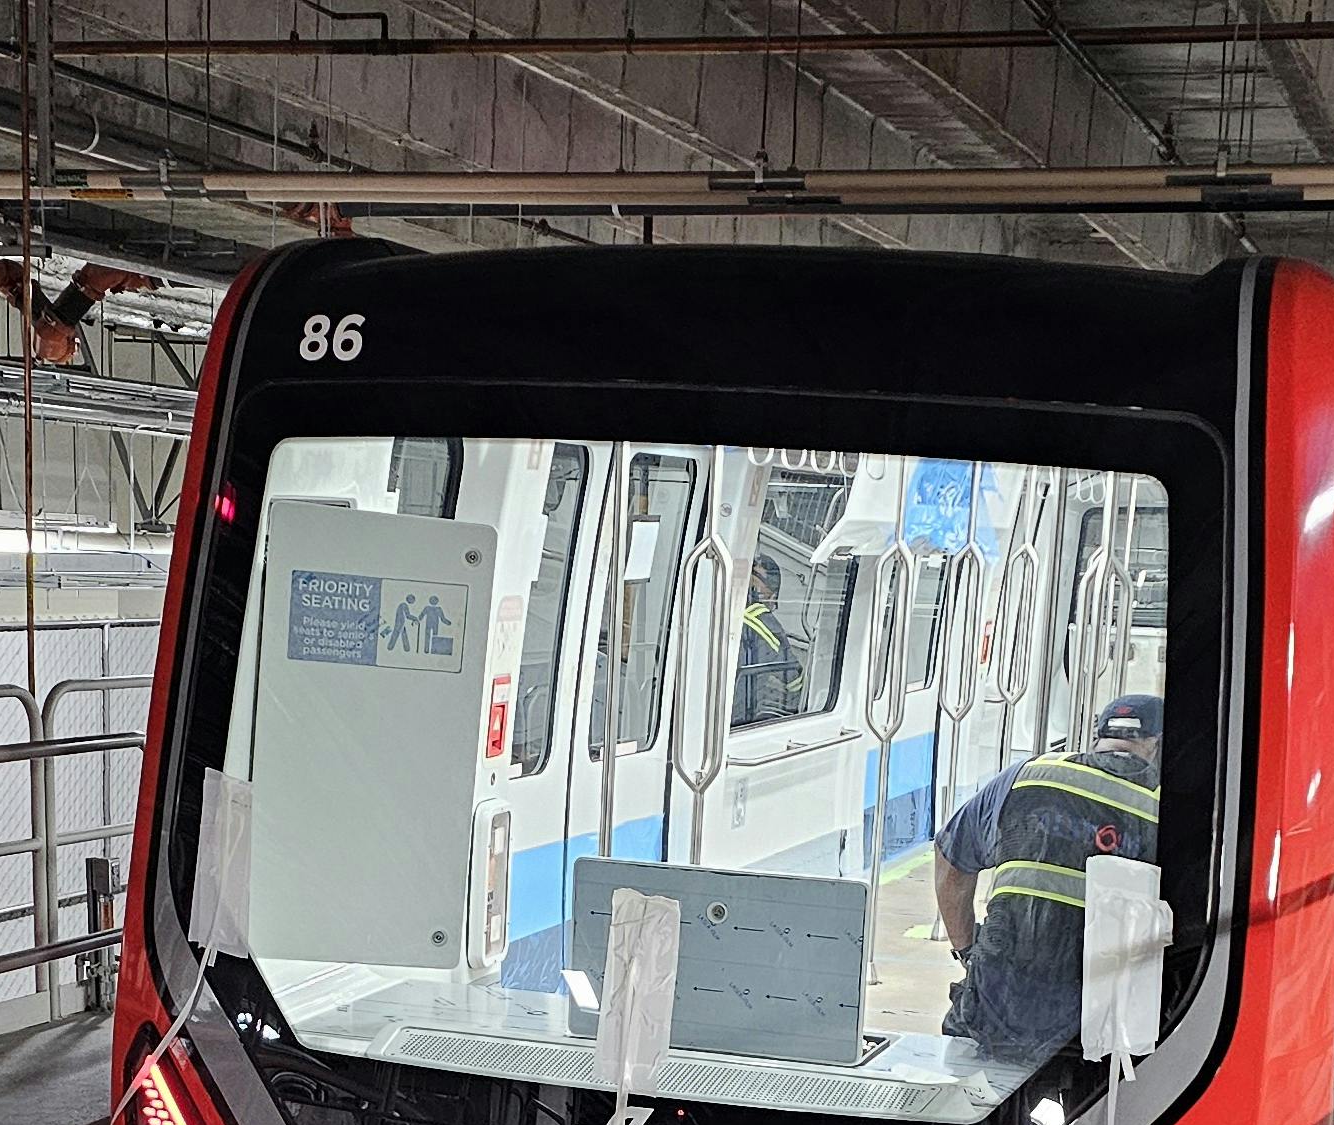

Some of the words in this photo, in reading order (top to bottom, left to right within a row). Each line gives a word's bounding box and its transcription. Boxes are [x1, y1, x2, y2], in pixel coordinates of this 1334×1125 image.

[299, 313, 366, 362] 86
[298, 578, 373, 597] PRIORITY
[301, 594, 370, 612] SEATING
[302, 616, 339, 627] Please
[340, 620, 365, 631] yield
[323, 627, 335, 638] to
[337, 629, 375, 641] senios
[303, 637, 316, 646] or
[317, 637, 363, 649] disabled
[302, 645, 362, 659] passengers
